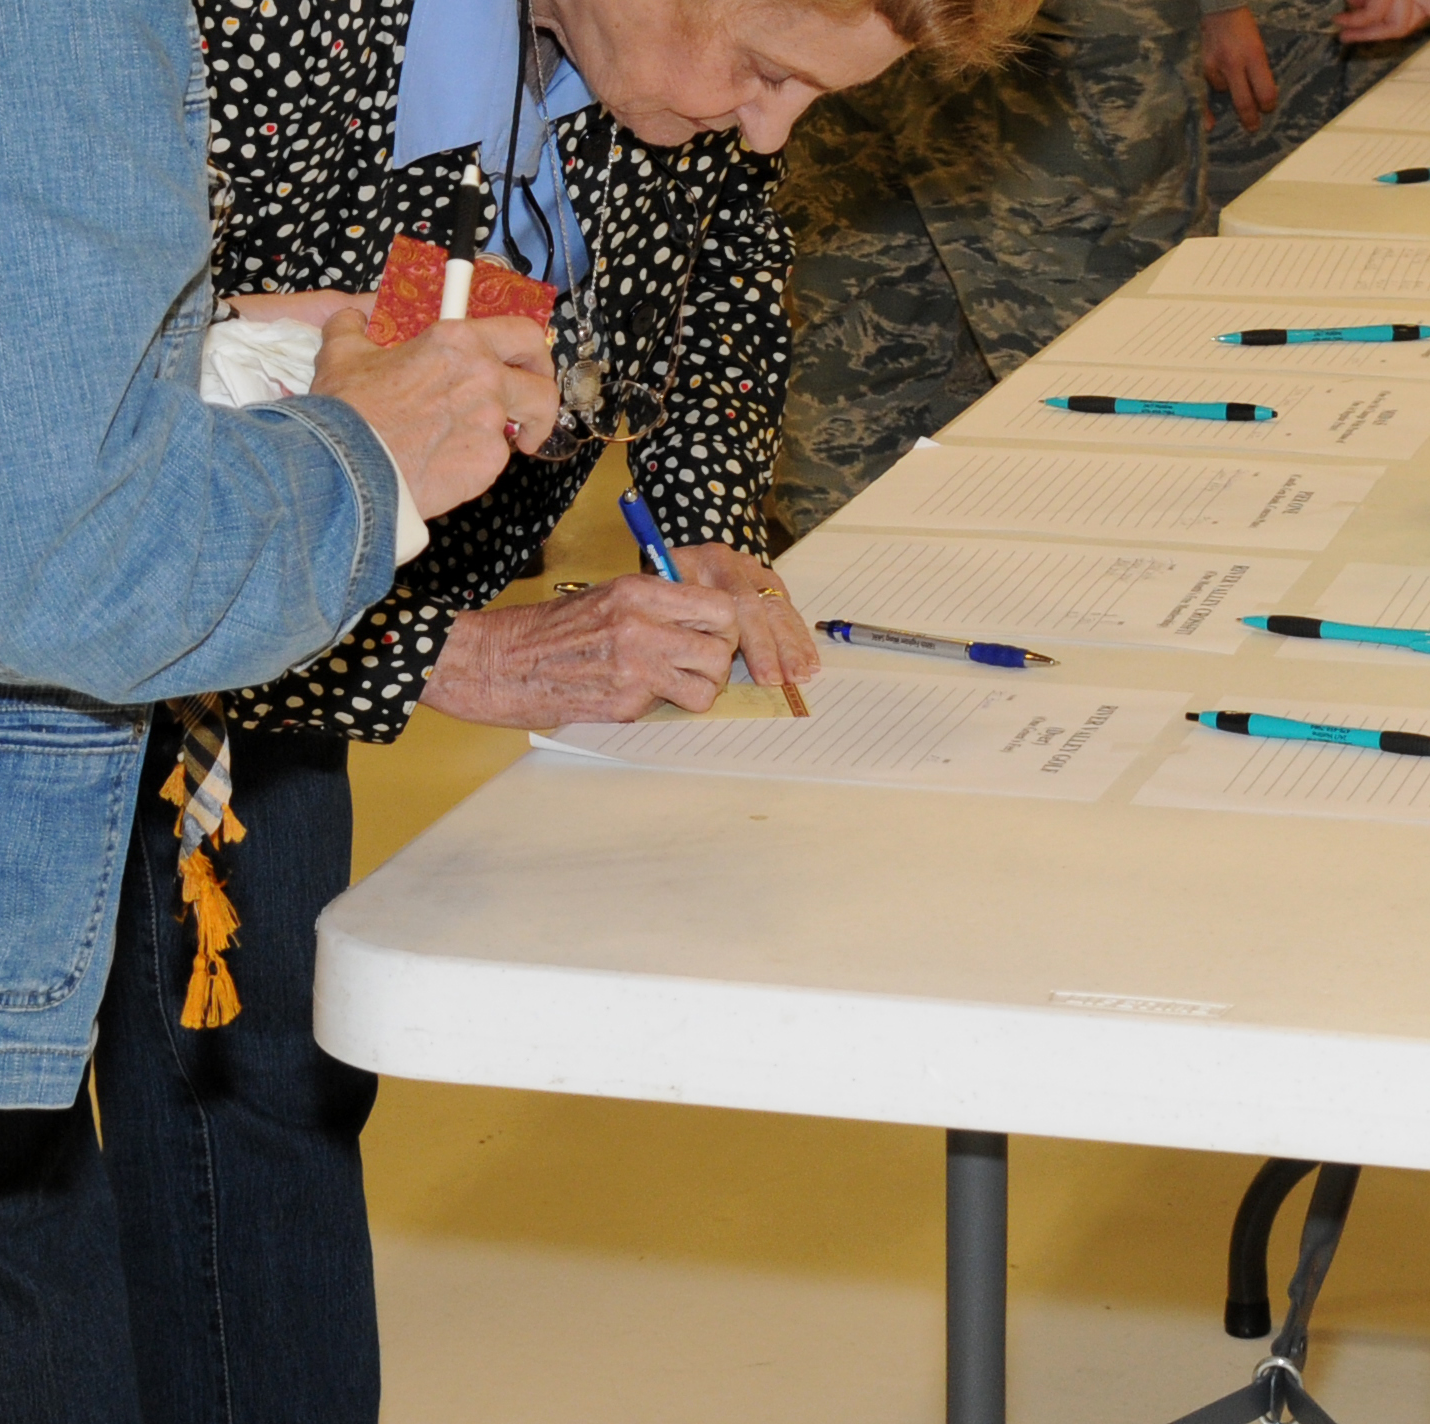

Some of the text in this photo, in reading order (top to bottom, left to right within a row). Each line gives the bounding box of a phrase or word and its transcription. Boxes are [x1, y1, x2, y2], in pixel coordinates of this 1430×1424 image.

[1220, 565, 1250, 583] RIVER
[1200, 584, 1234, 606] VALLEY
[1040, 704, 1119, 774] RIVER VALLEY GOLF
